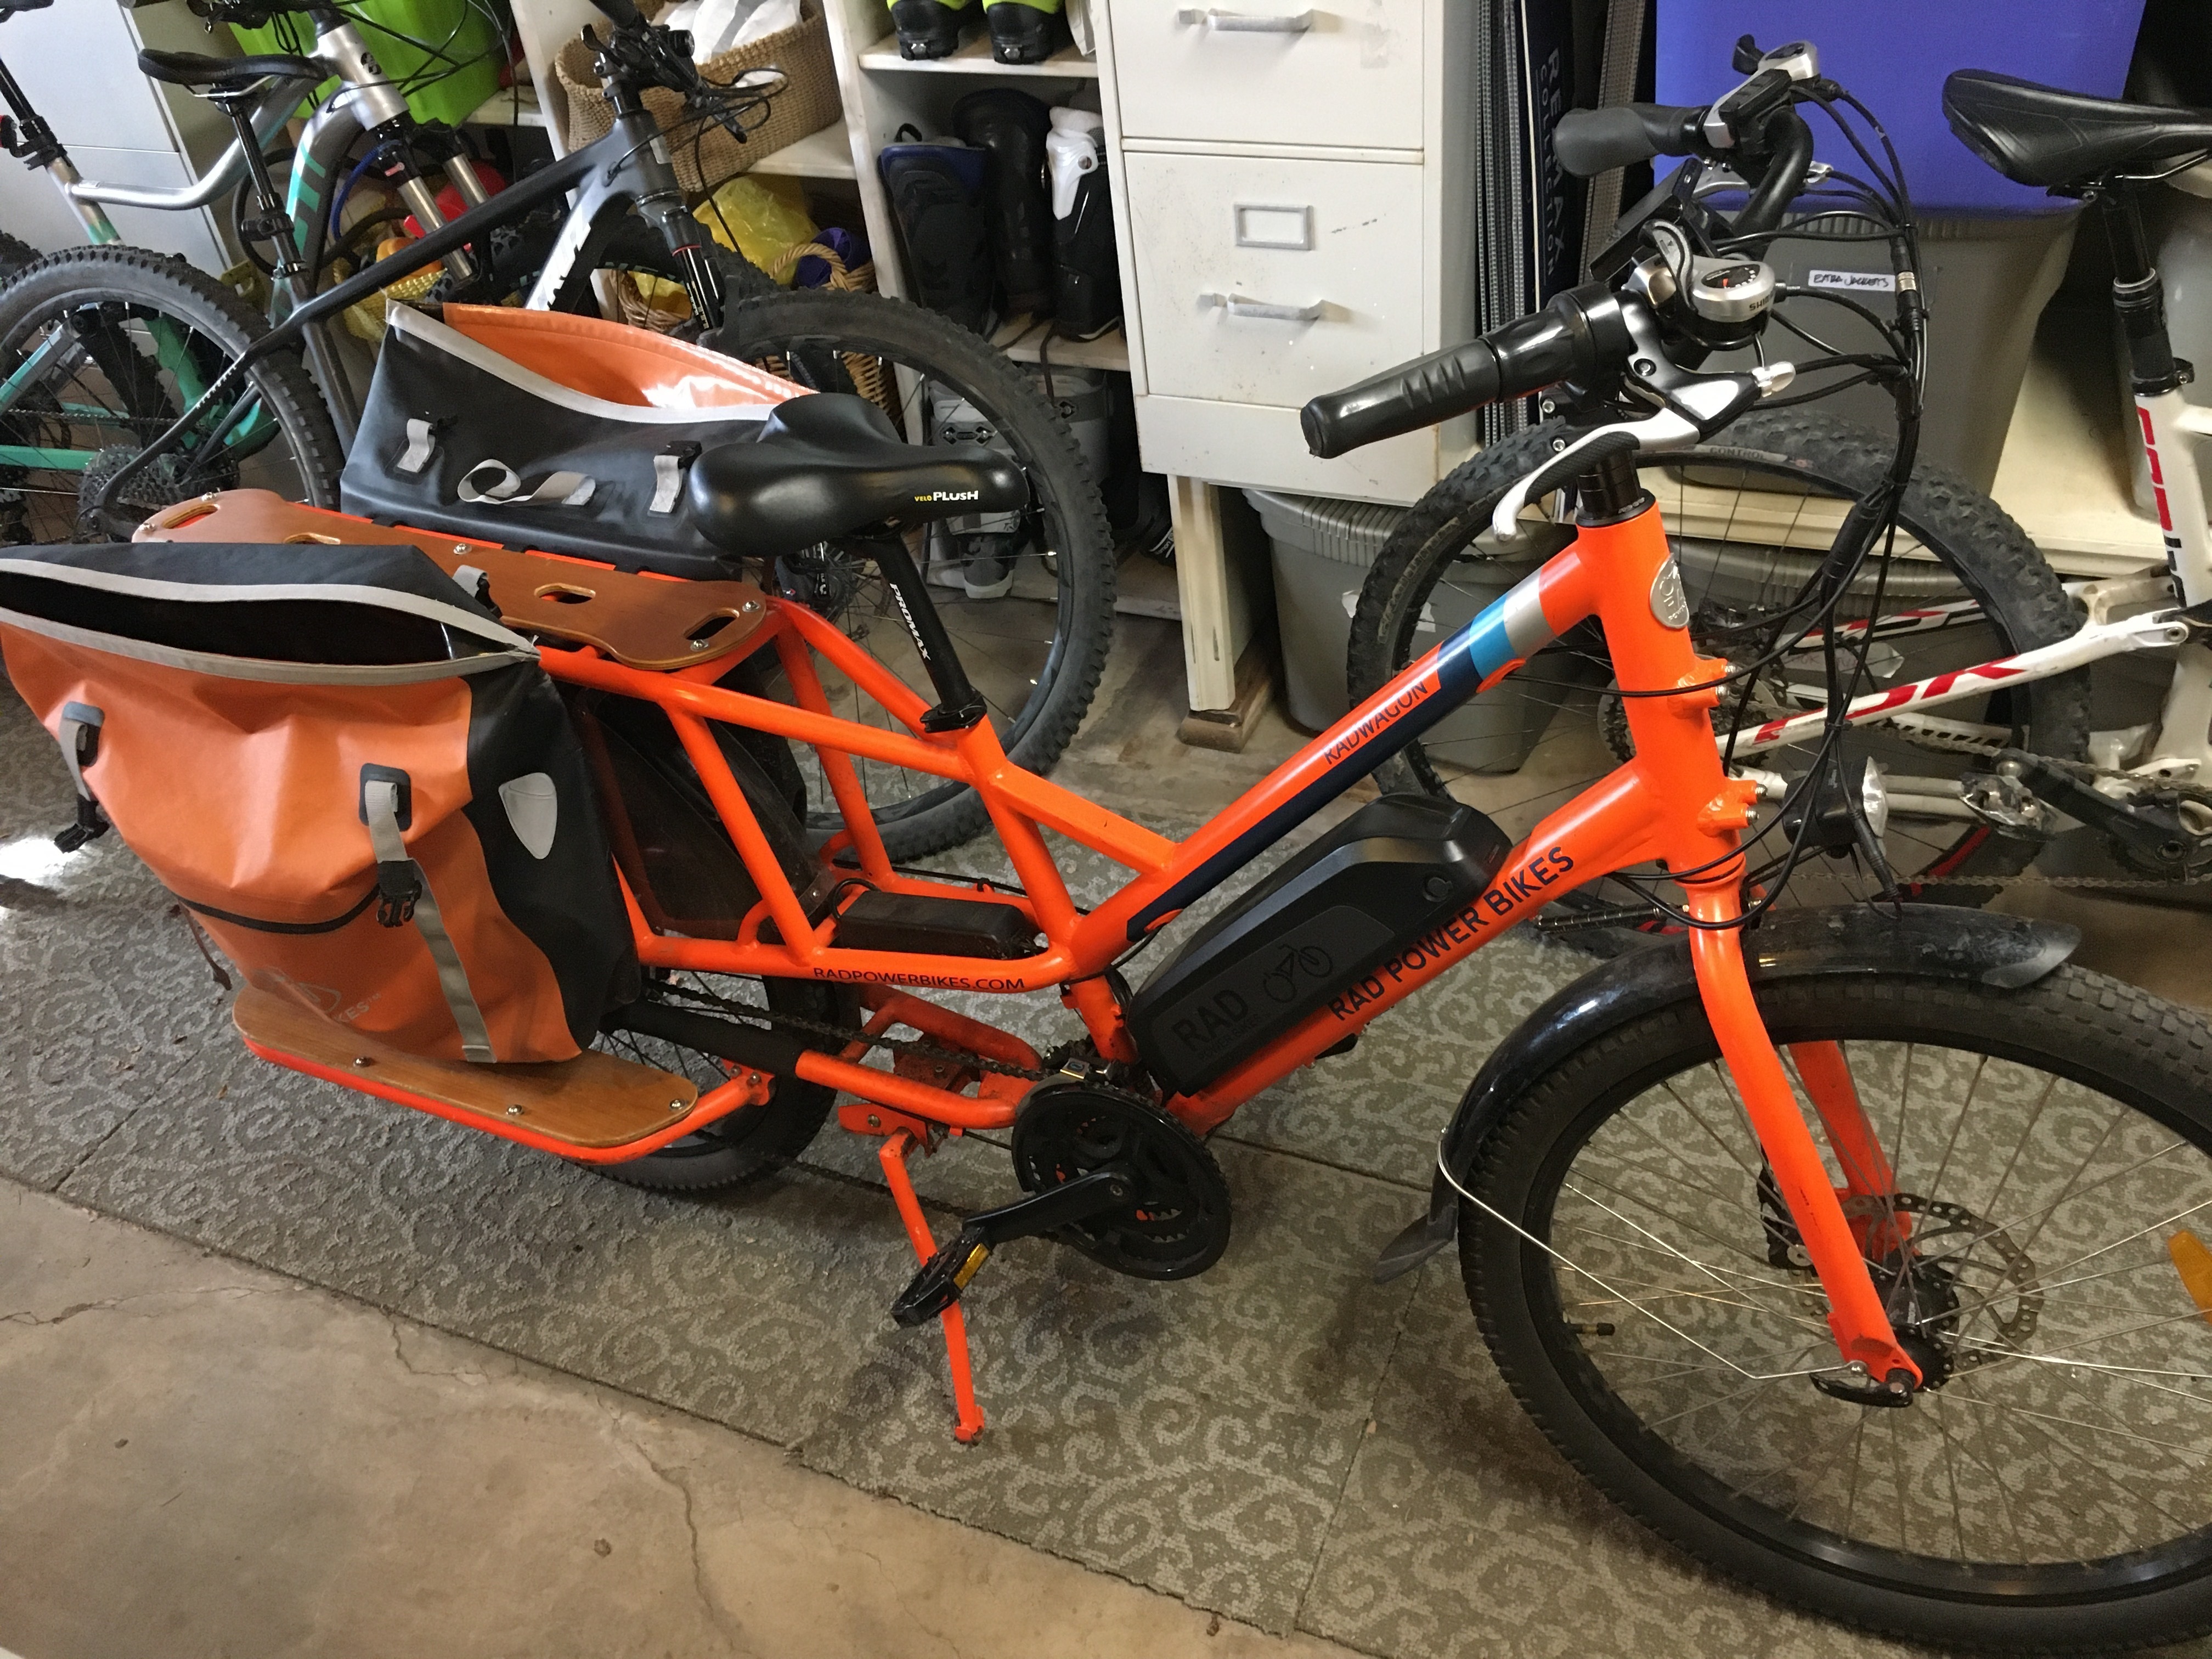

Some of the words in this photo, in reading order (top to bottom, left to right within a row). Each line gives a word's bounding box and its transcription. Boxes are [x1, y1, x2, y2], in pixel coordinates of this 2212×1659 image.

[1541, 64, 1555, 275] COLLECTION
[1748, 295, 1772, 311] SHIM
[1710, 447, 1764, 460] CONTROL
[933, 490, 979, 501] PLUSH
[889, 583, 932, 661] PROMAX
[1323, 681, 1429, 765] RADWAGON
[1327, 974, 1385, 1021] RAD
[1384, 906, 1489, 983] POWER
[1483, 846, 1575, 916] BIKES
[813, 967, 1025, 990] RADPOWERBIKES.COM
[1171, 989, 1249, 1052] RAD
